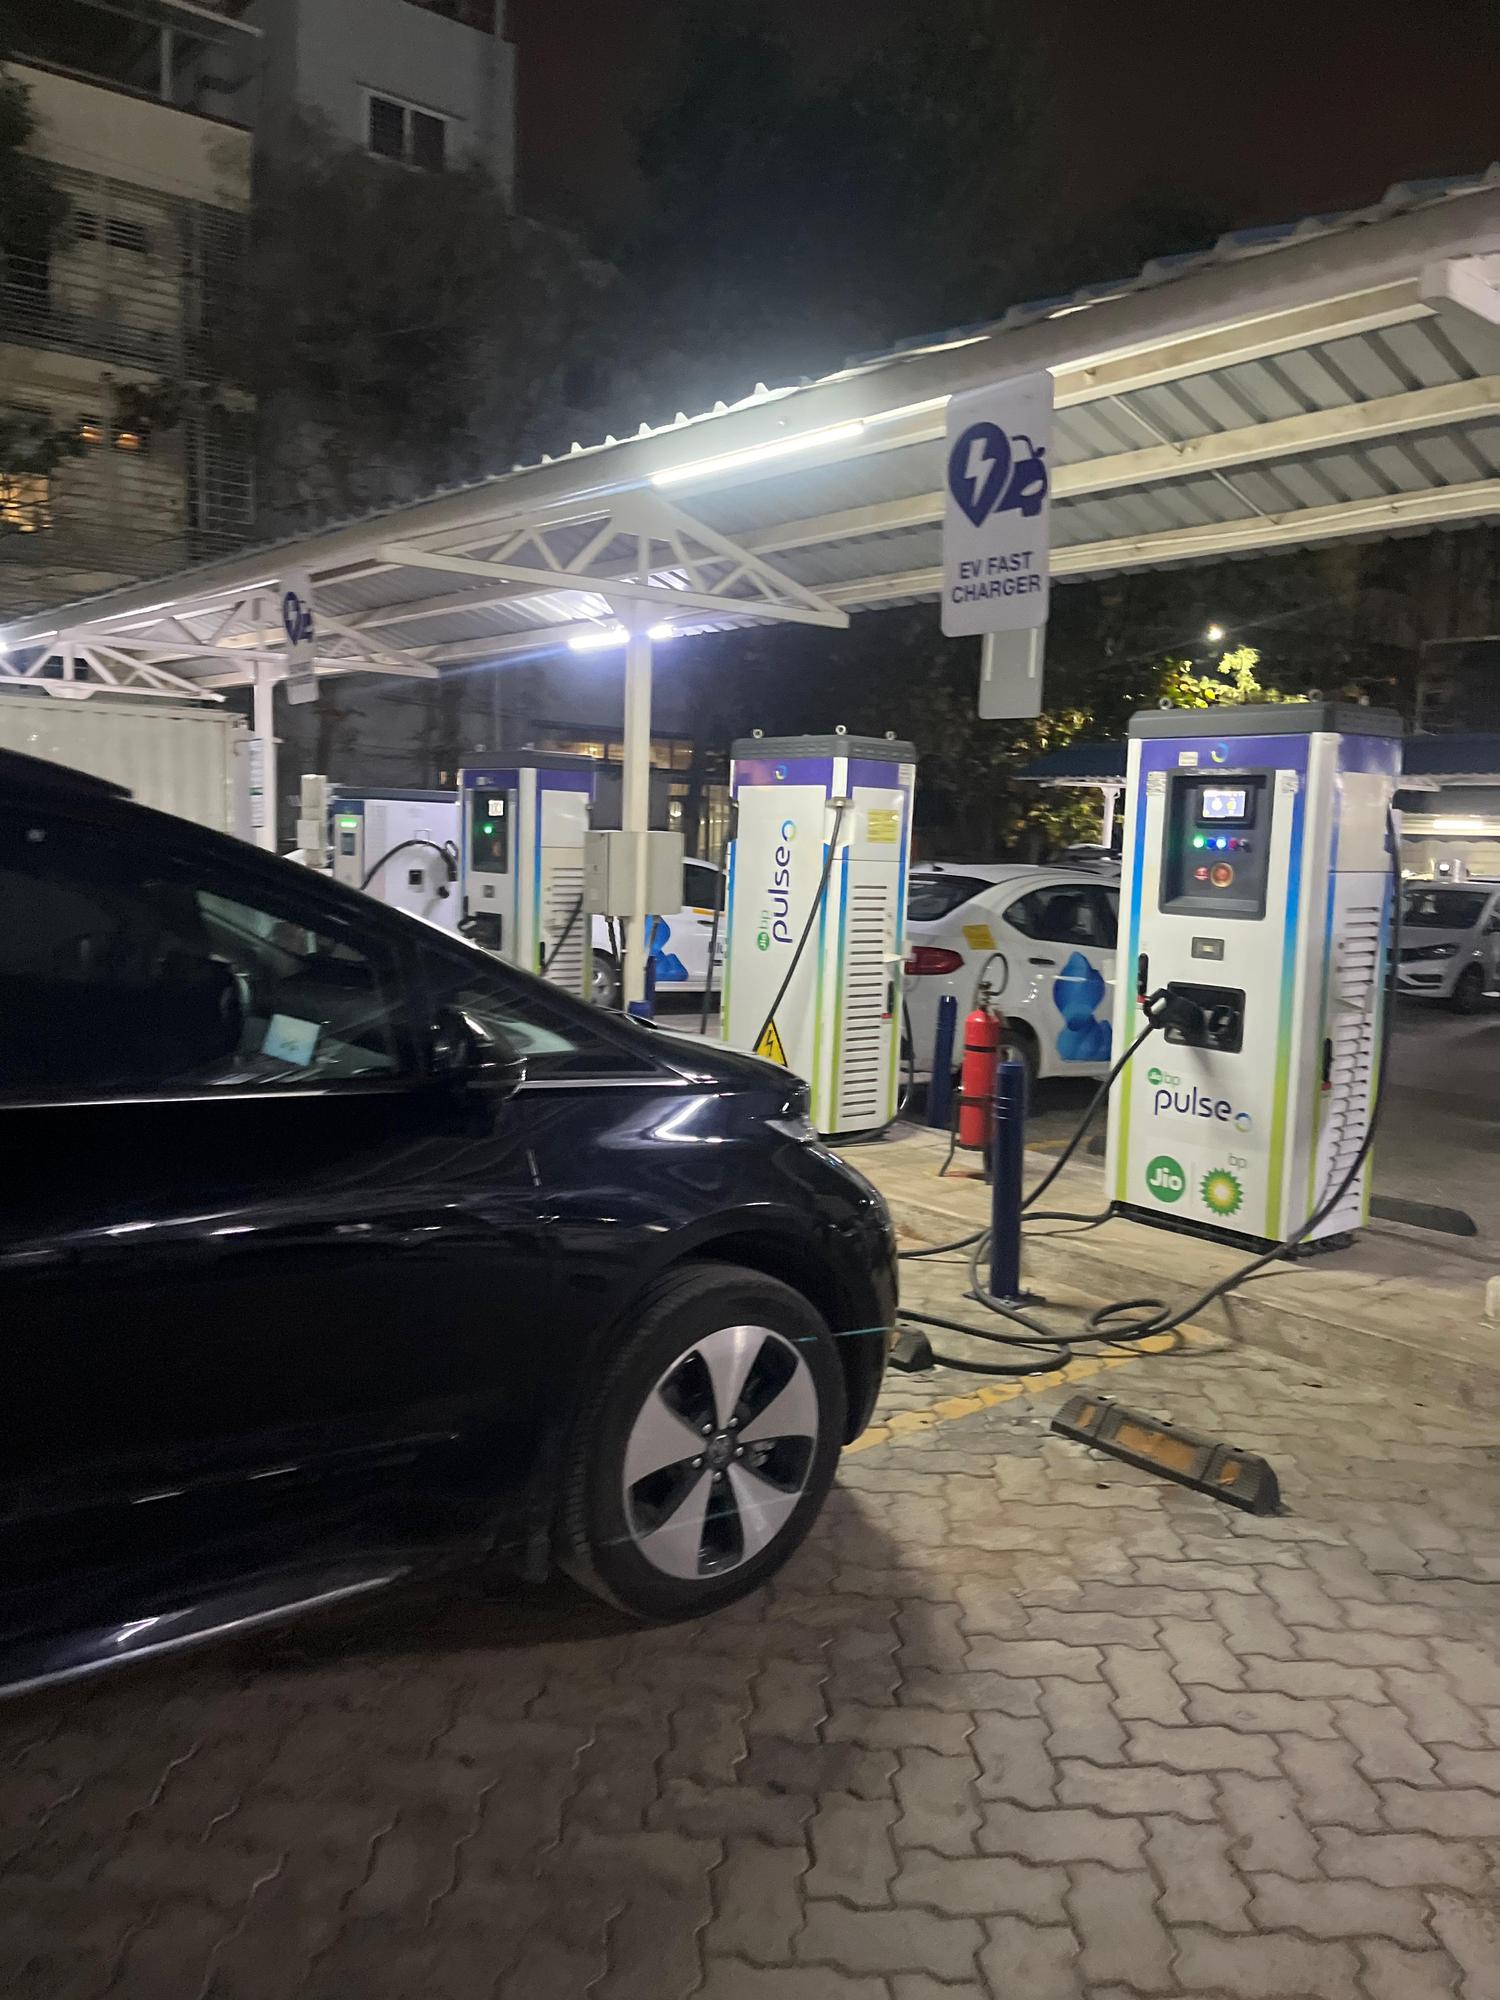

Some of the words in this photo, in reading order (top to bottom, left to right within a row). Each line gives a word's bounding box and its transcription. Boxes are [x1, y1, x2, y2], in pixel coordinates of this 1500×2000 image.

[960, 559, 981, 579] EV
[988, 551, 1034, 575] FAST
[952, 574, 1041, 603] CHARGER
[767, 845, 793, 943] pulse
[1164, 1072, 1181, 1088] bp
[1154, 1086, 1232, 1121] pulse
[1228, 1153, 1247, 1170] bp
[1149, 1167, 1183, 1192] Jio
